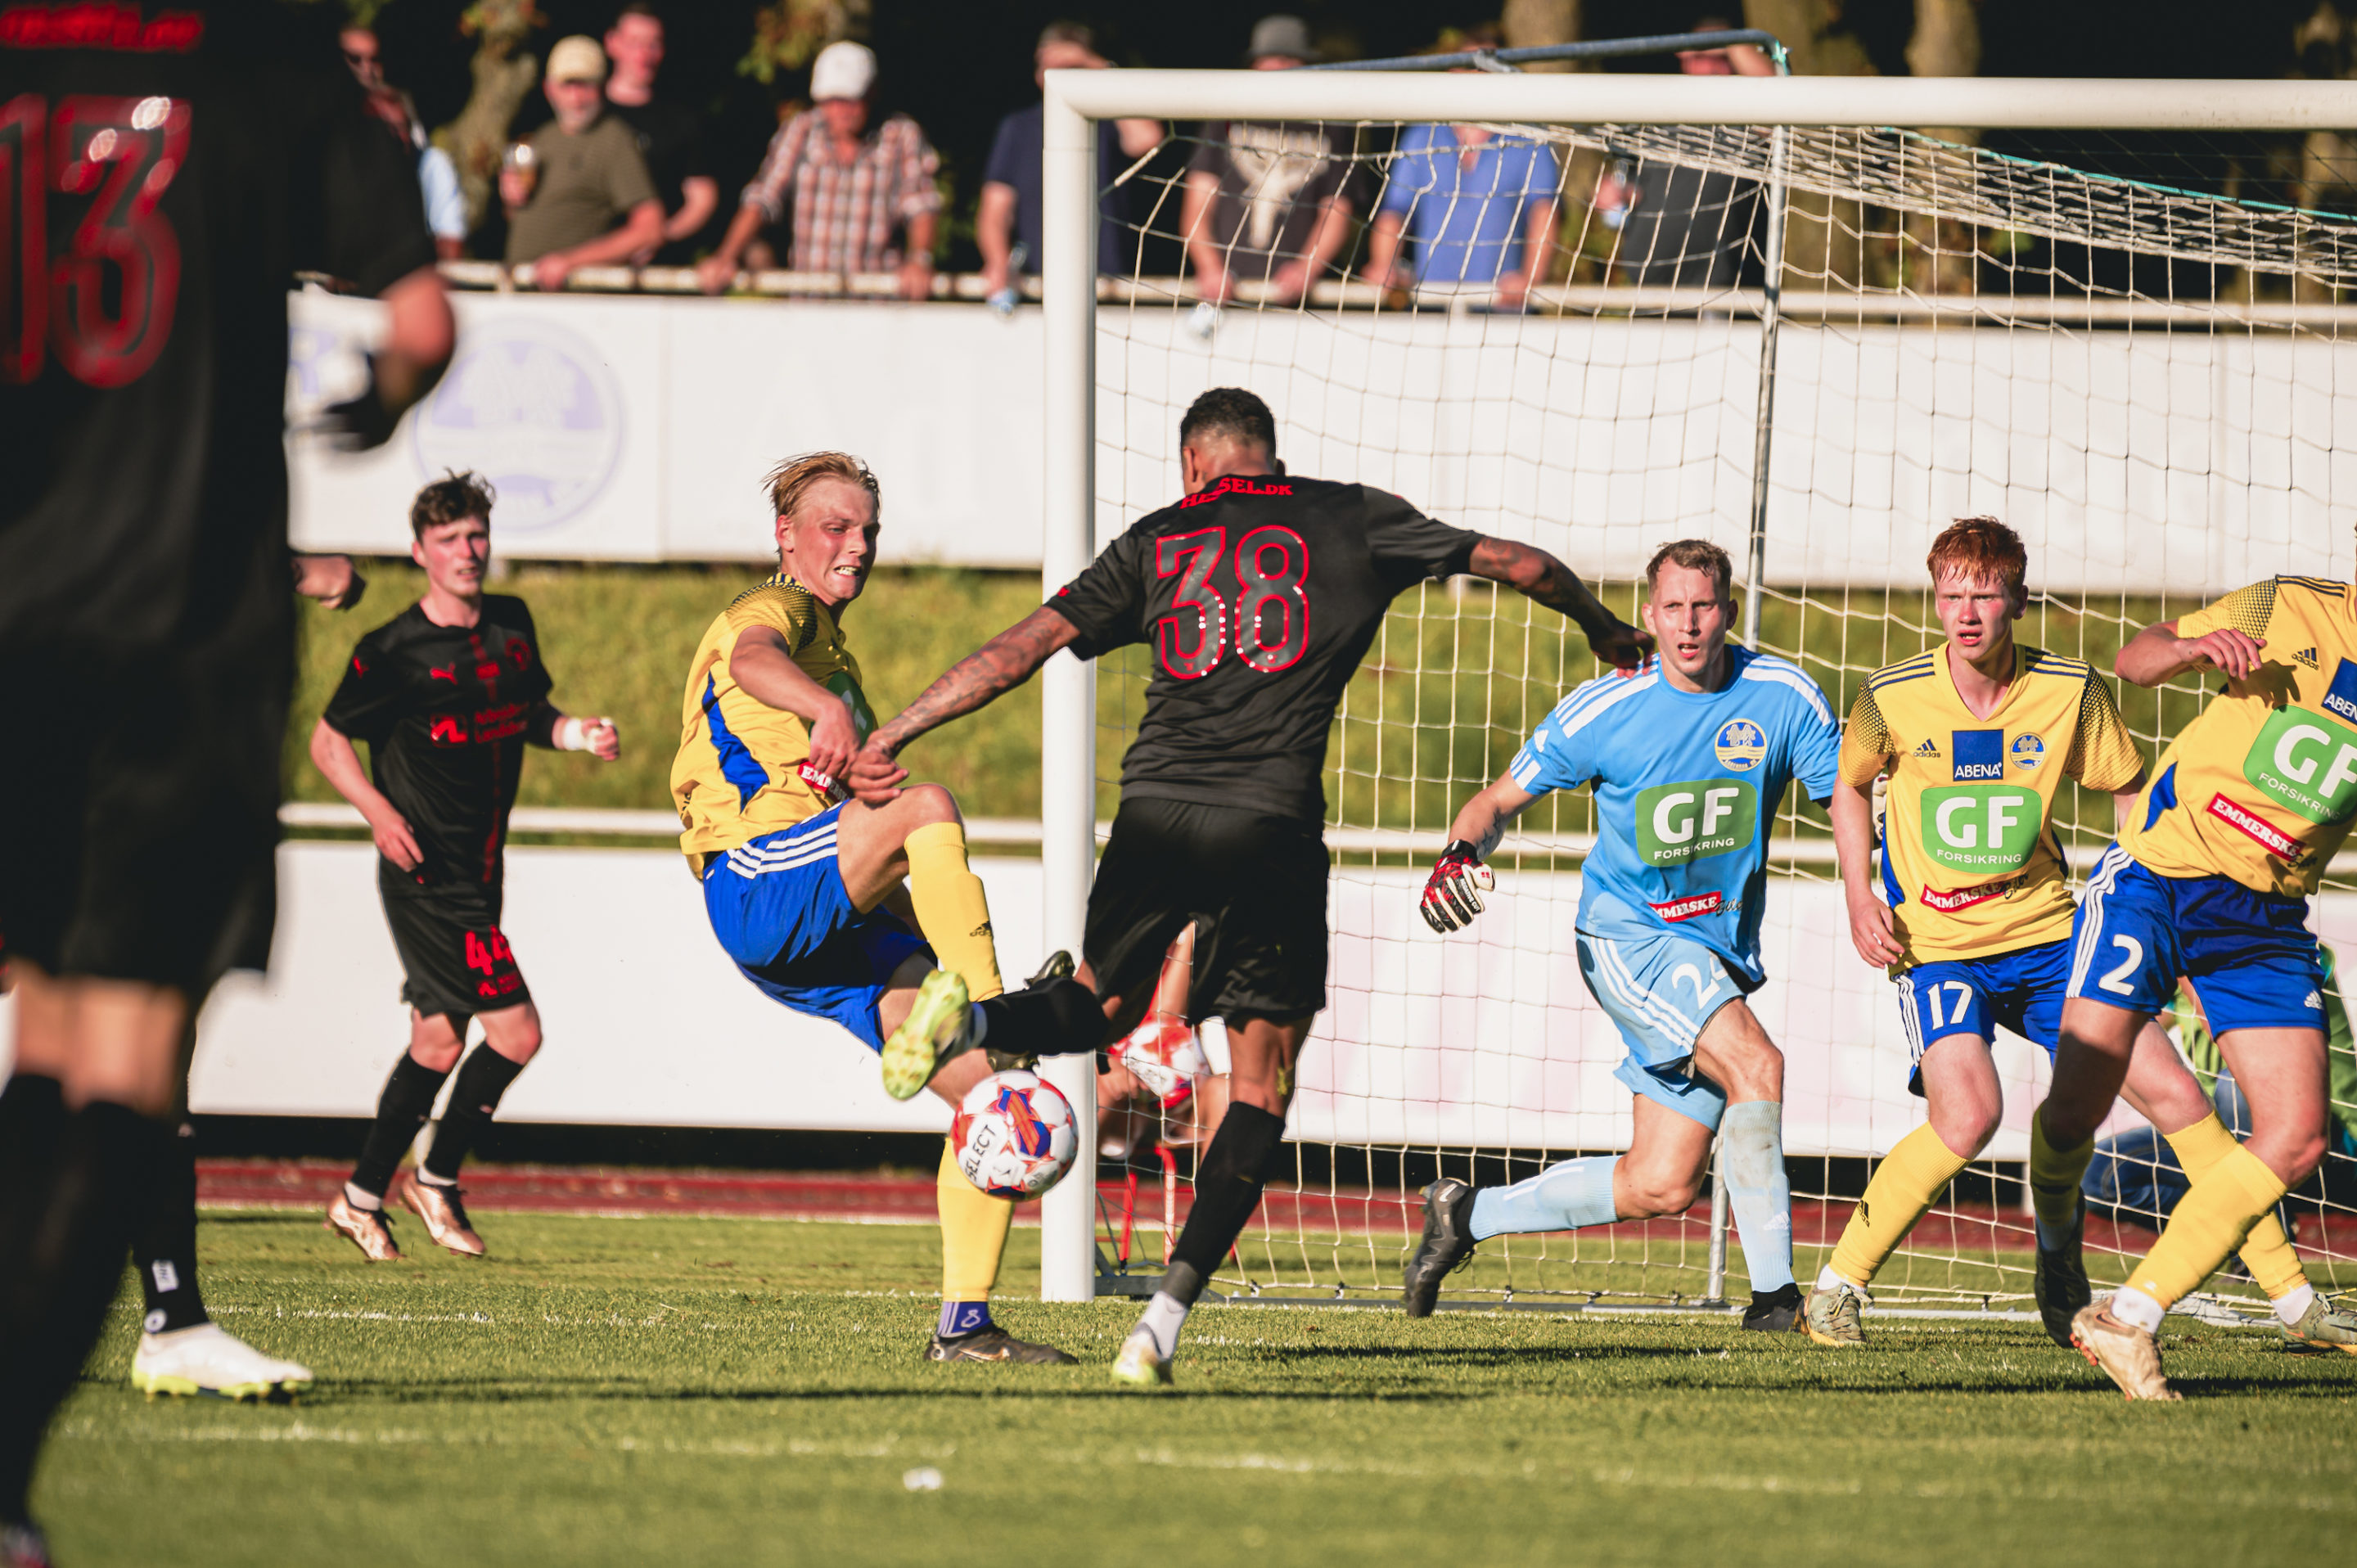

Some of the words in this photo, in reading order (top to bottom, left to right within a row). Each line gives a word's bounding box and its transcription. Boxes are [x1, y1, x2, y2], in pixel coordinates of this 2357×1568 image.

[1156, 525, 1309, 680] 38
[1913, 750, 1941, 759] adidas
[1954, 763, 2002, 778] ABENA
[2274, 724, 2357, 799] GF
[1653, 787, 1739, 844] GF
[1936, 795, 2024, 848] GF
[2259, 772, 2340, 820] FORSIKRING
[1654, 838, 1735, 860] FORSIKRING
[2212, 798, 2301, 857] EMMERSKE
[1936, 849, 2022, 864] FORSIKRING
[1652, 896, 1718, 919] MMERSKE
[1924, 881, 2002, 908] EMMERSKE
[465, 922, 515, 976] 44
[2098, 934, 2143, 996] 2
[1927, 980, 1973, 1030] 17
[964, 1124, 996, 1183] SELECT
